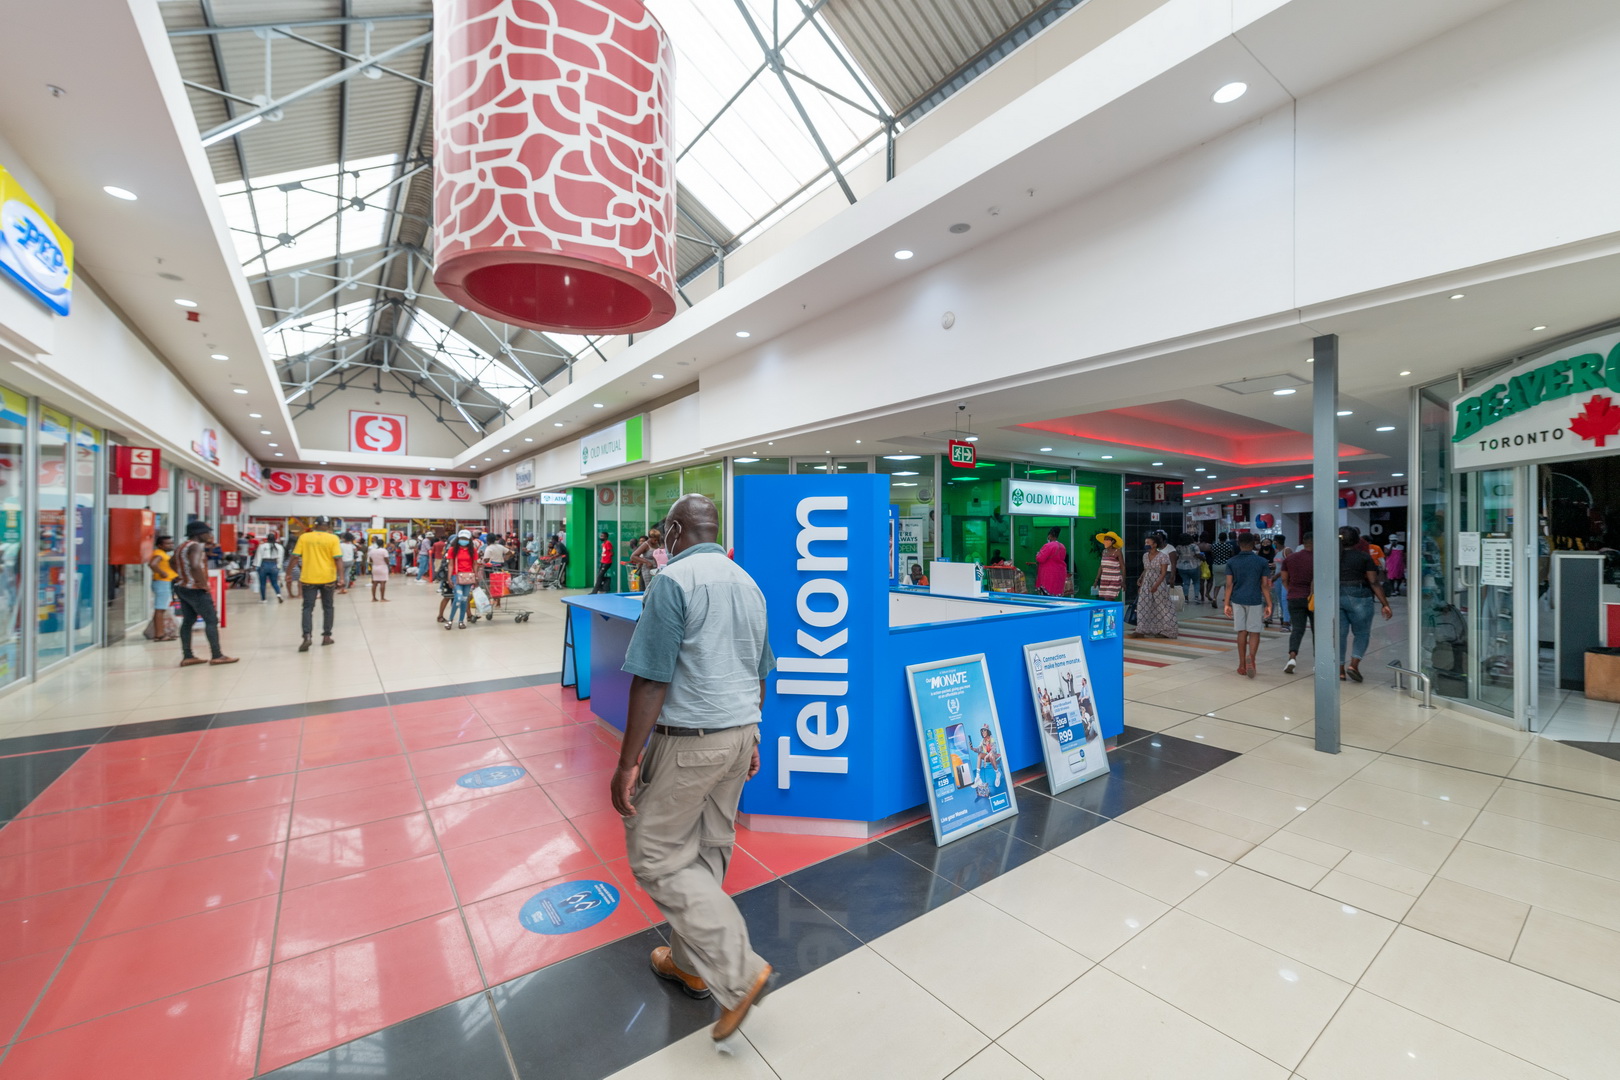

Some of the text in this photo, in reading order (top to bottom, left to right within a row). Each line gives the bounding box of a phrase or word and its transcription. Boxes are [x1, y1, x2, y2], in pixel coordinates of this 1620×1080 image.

[1479, 428, 1564, 451] TORONTO
[268, 471, 471, 501] SHOPRITE
[1026, 493, 1075, 506] OLD MUTUAL
[776, 496, 849, 790] Telkom
[931, 671, 967, 689] MONATE
[1059, 729, 1073, 742] R99
